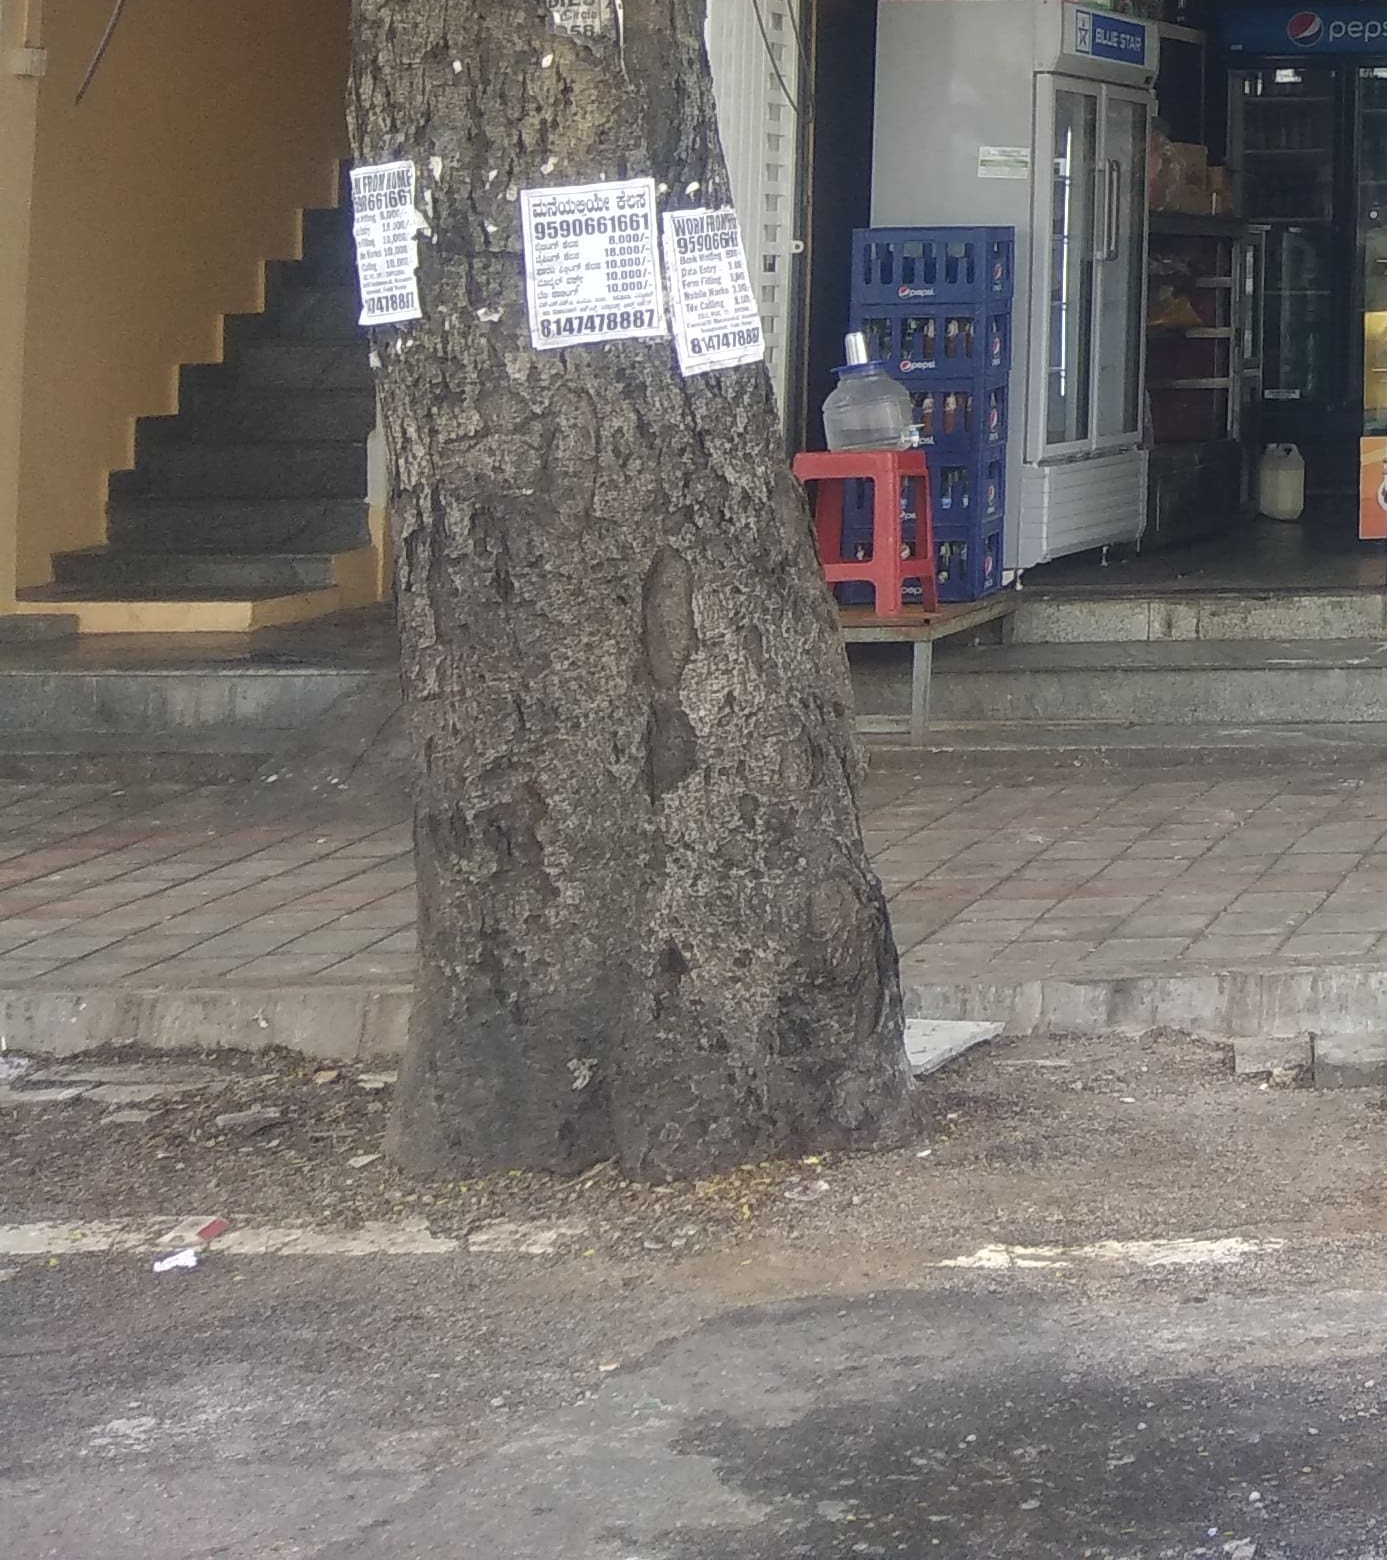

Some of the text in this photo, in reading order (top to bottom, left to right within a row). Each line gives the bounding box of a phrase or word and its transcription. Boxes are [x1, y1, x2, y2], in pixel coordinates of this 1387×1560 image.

[1095, 27, 1143, 52] BLUE STAR
[534, 212, 650, 241] 9590661661
[673, 217, 705, 238] WORK
[909, 286, 935, 297] pepsi
[540, 308, 655, 338] 8147478887
[911, 359, 936, 370] pepsi
